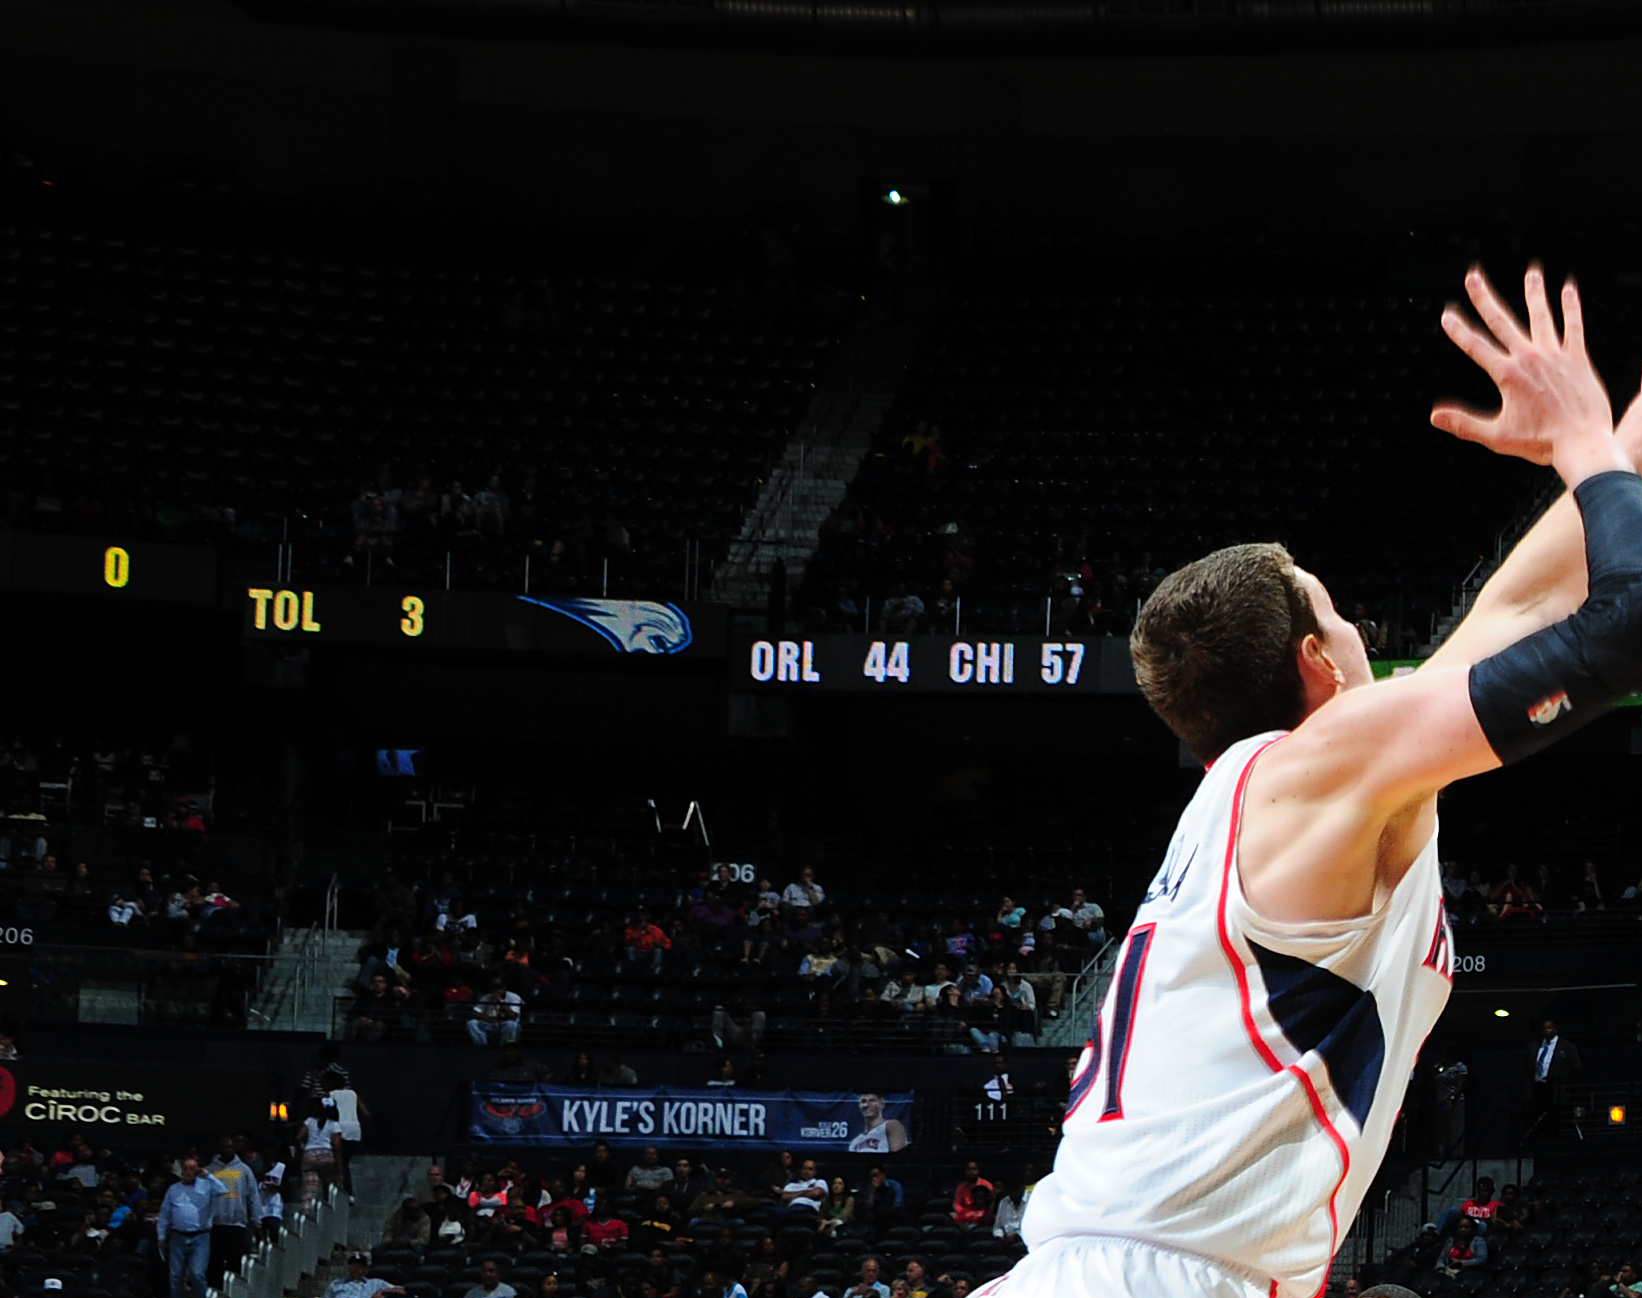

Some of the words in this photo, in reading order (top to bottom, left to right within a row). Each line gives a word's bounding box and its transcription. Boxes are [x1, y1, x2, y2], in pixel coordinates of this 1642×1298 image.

[104, 546, 129, 588] 0
[248, 588, 321, 632] TOL
[401, 596, 425, 636] 3
[750, 641, 820, 683] ORL
[864, 641, 911, 683] 44
[950, 642, 1015, 684] CHI
[1041, 643, 1085, 685] 57
[27, 1085, 112, 1103] Featuring
[116, 1090, 145, 1103] the
[125, 1113, 166, 1126] BAR
[562, 1100, 655, 1134] KYLE'S
[663, 1103, 767, 1137] KORNER
[975, 1102, 1007, 1121] 111
[832, 1121, 849, 1138] 26
